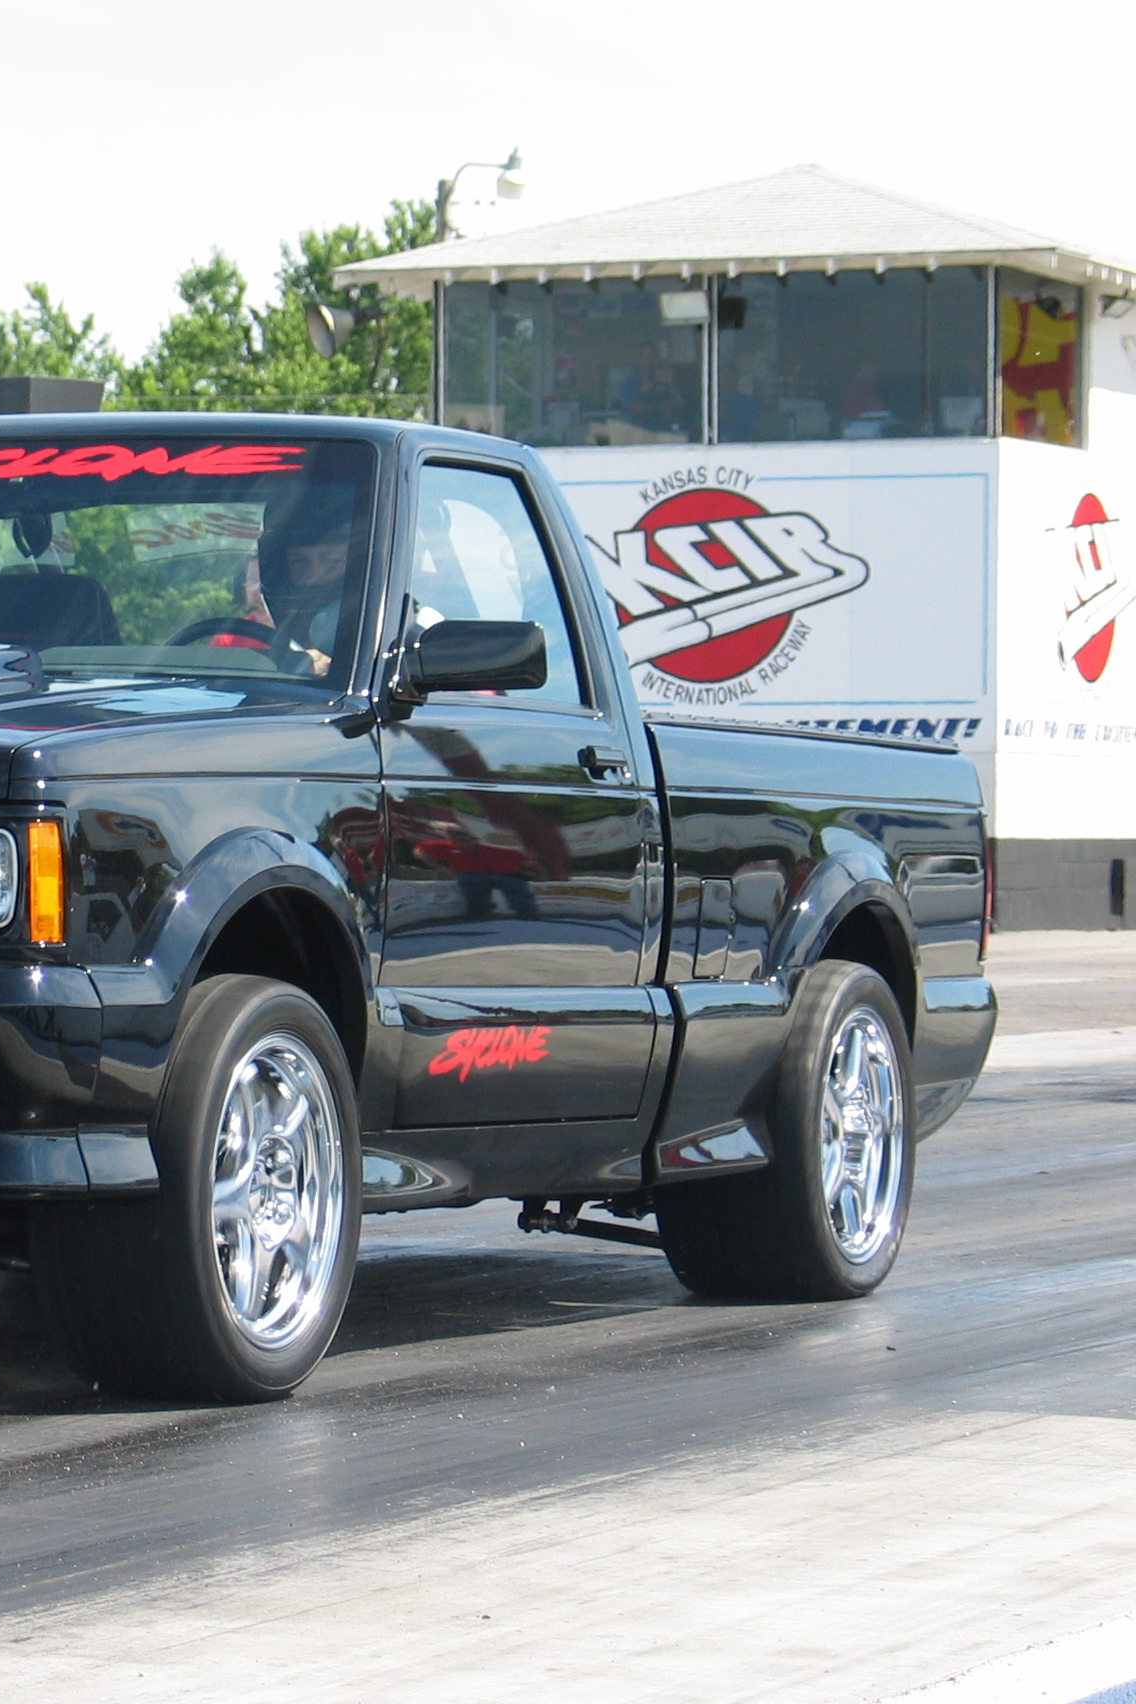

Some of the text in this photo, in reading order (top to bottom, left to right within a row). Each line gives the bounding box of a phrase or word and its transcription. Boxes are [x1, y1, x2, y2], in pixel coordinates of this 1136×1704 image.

[639, 465, 758, 505] KANSAS CITY
[641, 619, 813, 705] INTERNATIONAL RACEWAY
